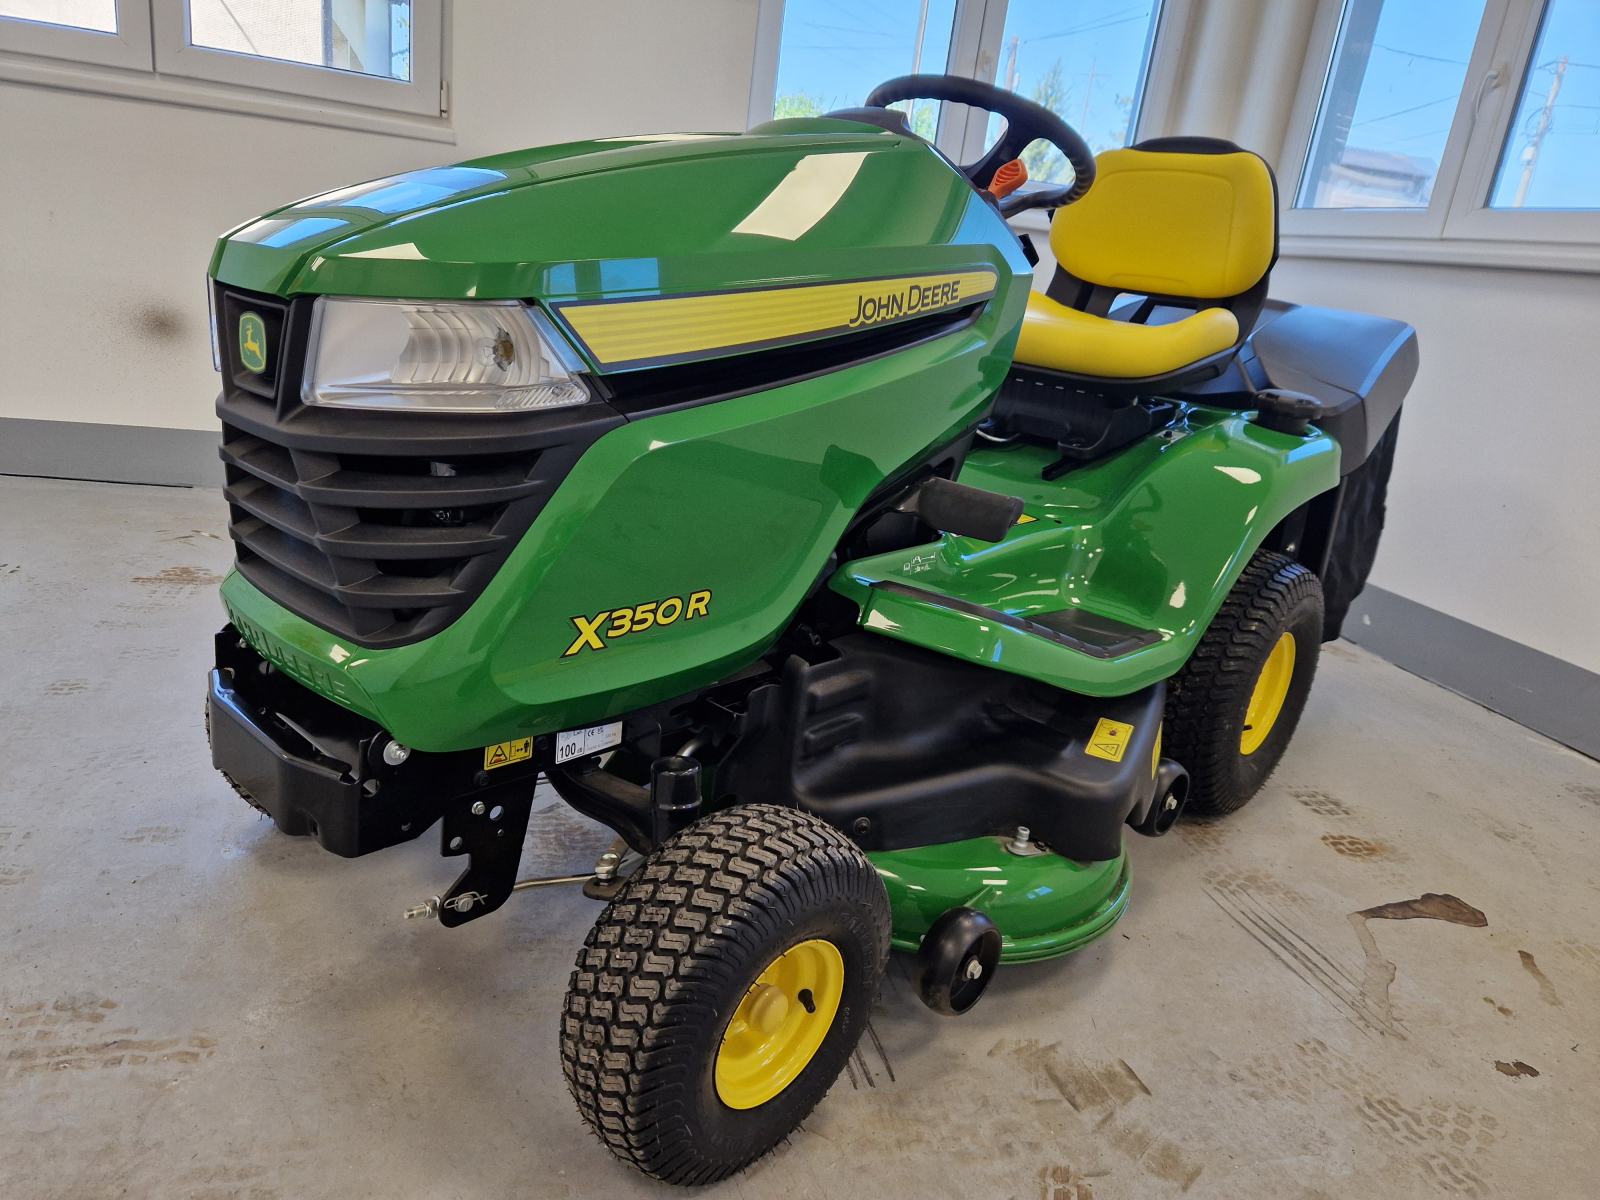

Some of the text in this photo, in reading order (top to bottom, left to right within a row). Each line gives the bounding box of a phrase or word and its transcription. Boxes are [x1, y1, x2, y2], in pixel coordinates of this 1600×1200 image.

[849, 280, 961, 326] JOHN DEERE
[561, 589, 712, 658] X350 R
[560, 743, 576, 759] 100
